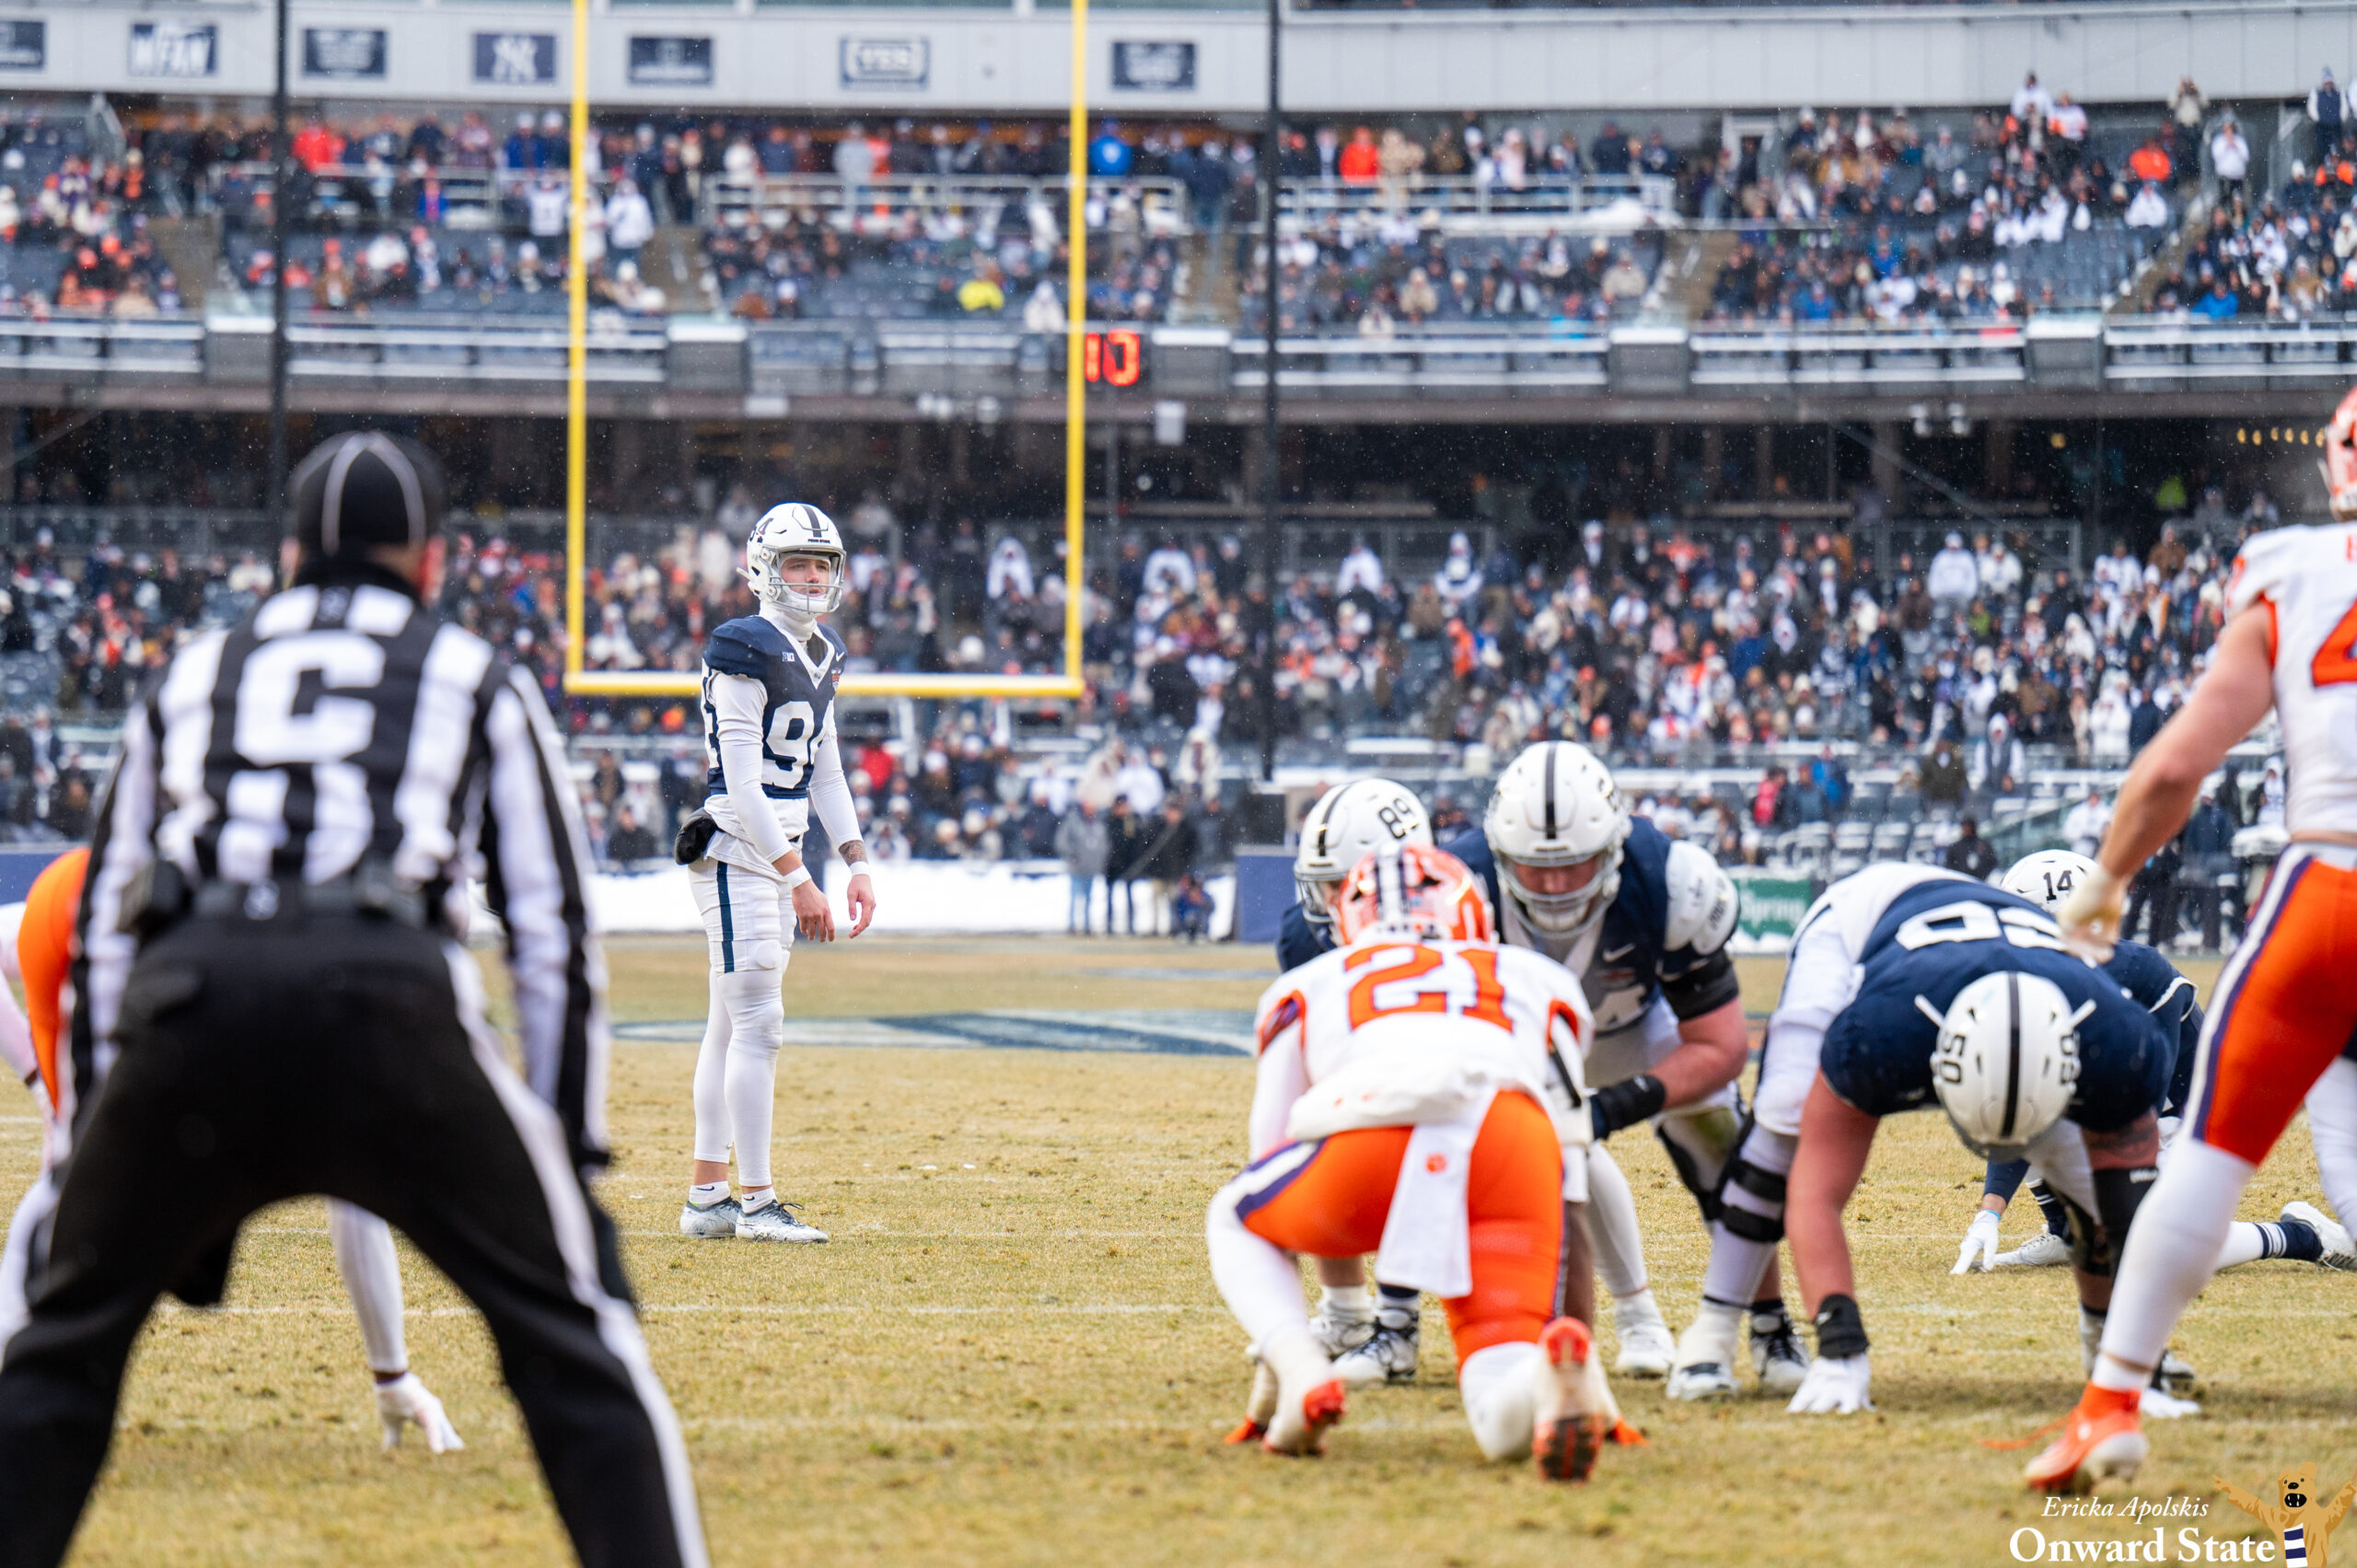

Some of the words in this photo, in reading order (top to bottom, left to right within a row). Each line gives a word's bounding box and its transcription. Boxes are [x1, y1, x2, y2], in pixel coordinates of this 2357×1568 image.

[1377, 796, 1416, 840] 89
[2043, 869, 2073, 901] 14
[1344, 941, 1515, 1034] 21
